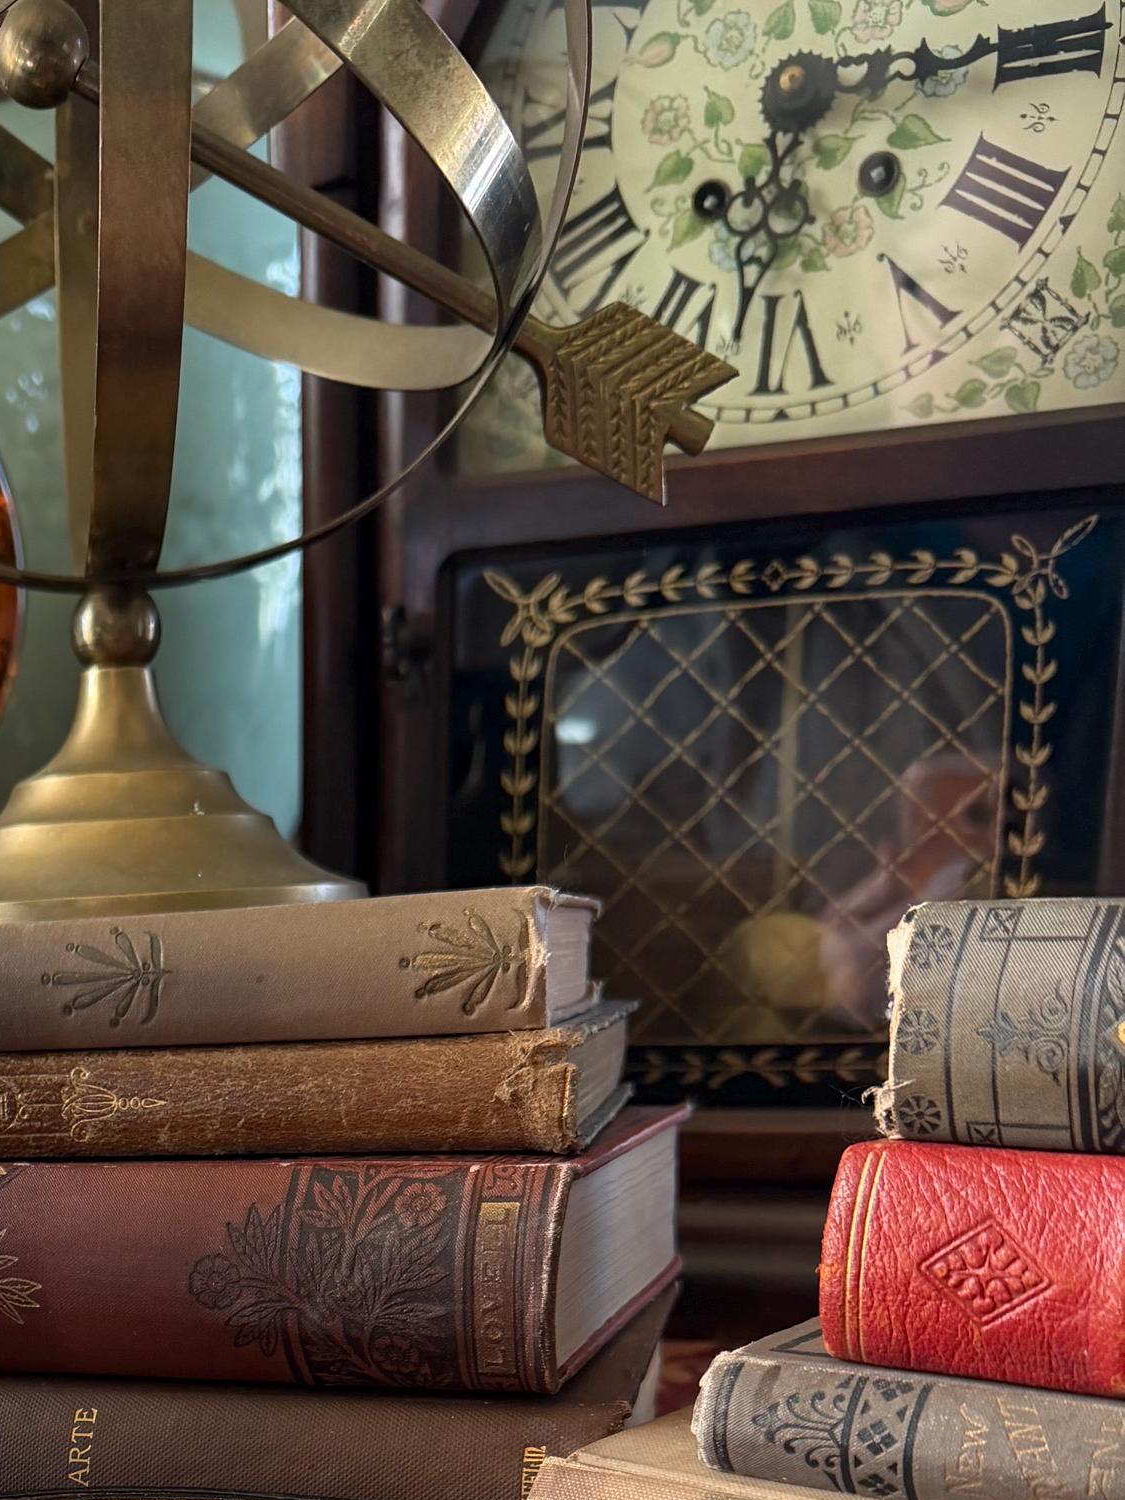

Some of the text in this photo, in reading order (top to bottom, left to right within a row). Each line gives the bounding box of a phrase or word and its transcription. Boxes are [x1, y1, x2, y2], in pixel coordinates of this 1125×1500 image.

[745, 288, 835, 396] VI
[875, 252, 963, 357] V
[68, 1407, 98, 1487] ARTE
